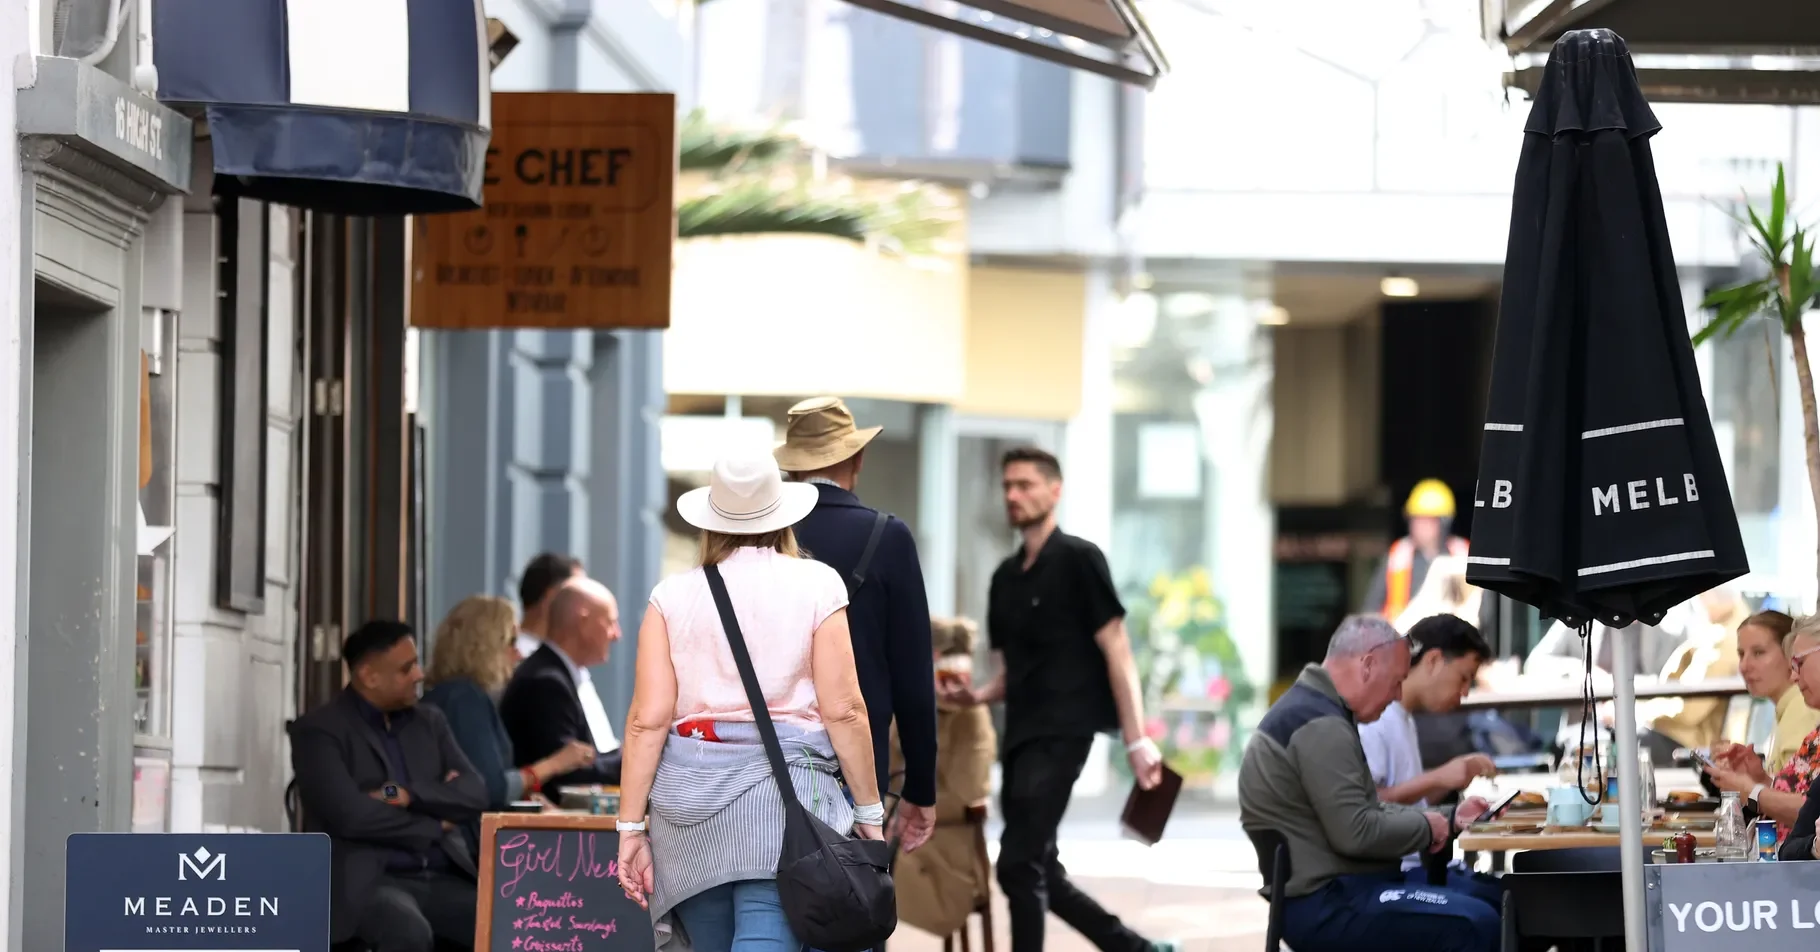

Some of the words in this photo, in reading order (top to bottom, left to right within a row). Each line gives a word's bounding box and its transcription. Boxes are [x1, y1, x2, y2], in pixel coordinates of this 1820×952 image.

[115, 96, 125, 140] 16
[126, 101, 149, 153] HIGH
[514, 147, 632, 187] CHEF
[500, 832, 563, 898] Girl
[568, 831, 619, 882] Nex
[124, 897, 278, 916] MEADEN
[1668, 900, 1778, 932] YOUR
[1791, 899, 1820, 929] L
[146, 926, 189, 934] MASTER
[195, 926, 257, 935] JEWELLERS
